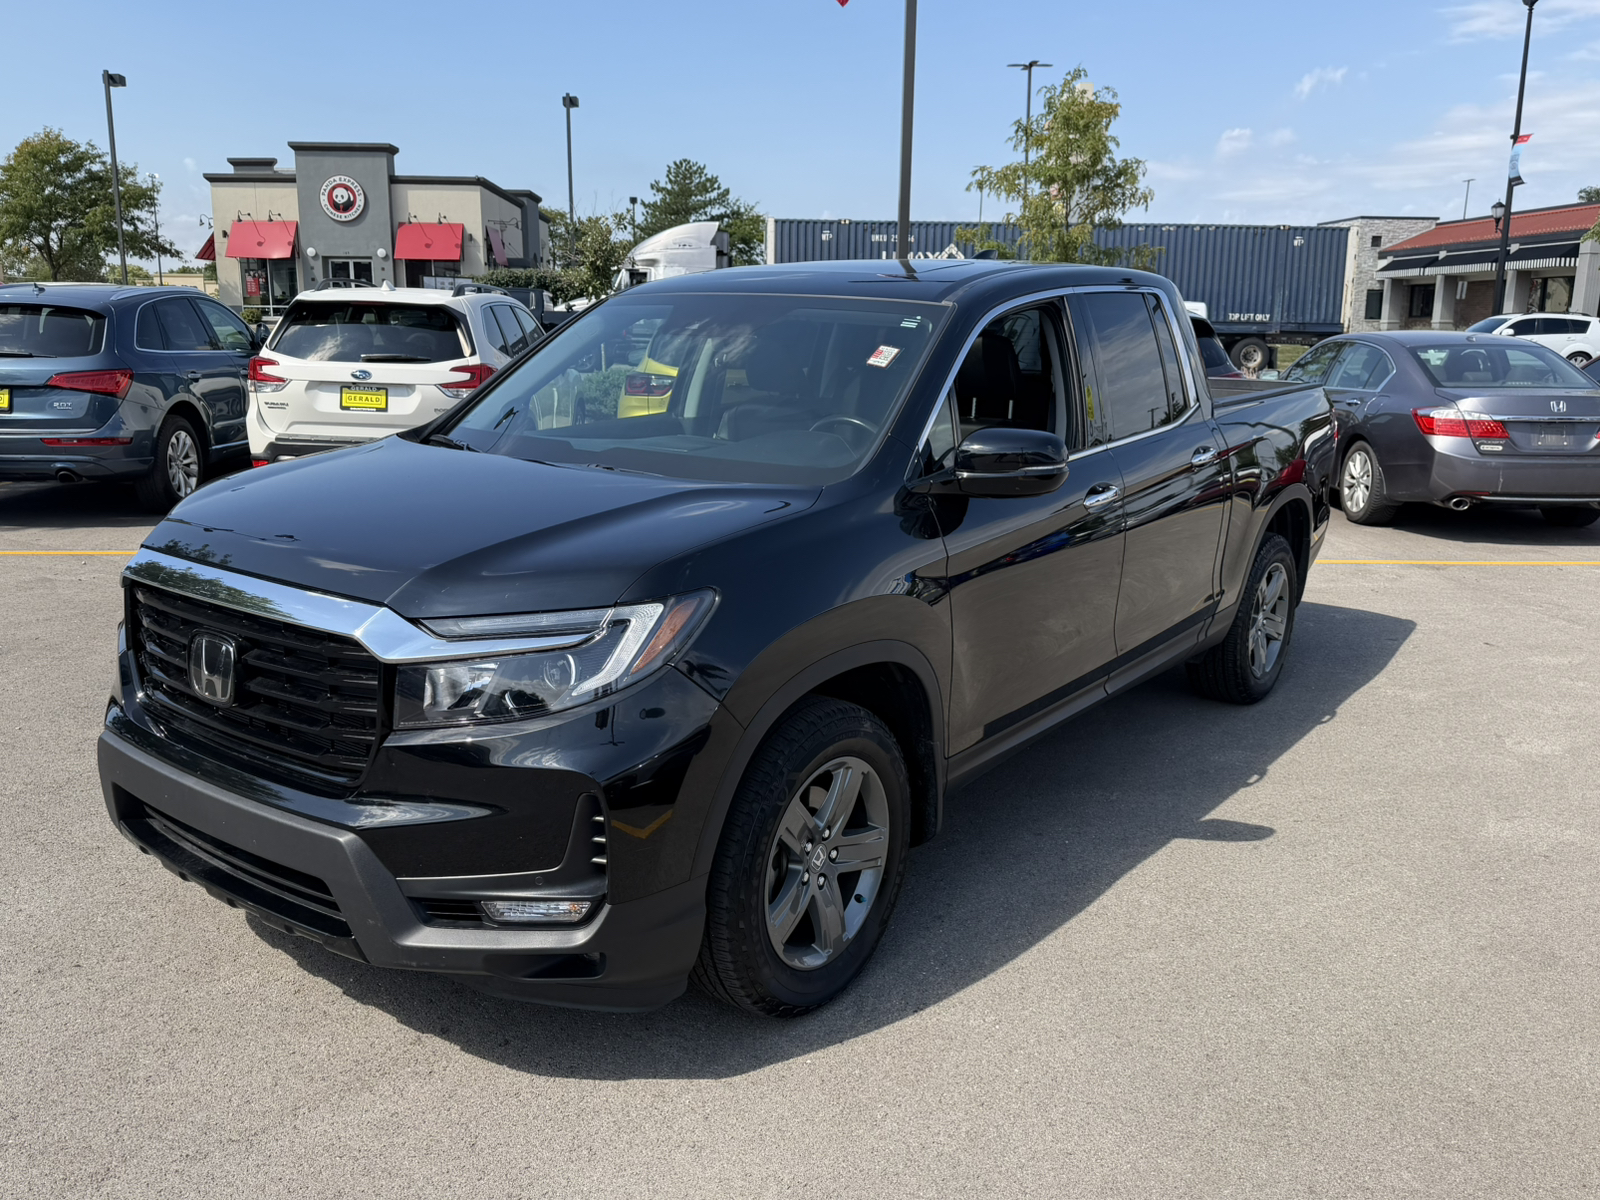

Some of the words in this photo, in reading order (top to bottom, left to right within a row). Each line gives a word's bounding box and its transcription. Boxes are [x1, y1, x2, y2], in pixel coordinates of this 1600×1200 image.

[322, 178, 337, 196] PANDA
[338, 177, 362, 197] EXPRESS
[323, 203, 342, 219] CHINESE
[344, 204, 362, 219] KITCHEN
[1228, 312, 1240, 321] TOP
[1240, 313, 1255, 321] LIFT
[1255, 313, 1271, 322] ONLY
[347, 395, 381, 403] GERALD
